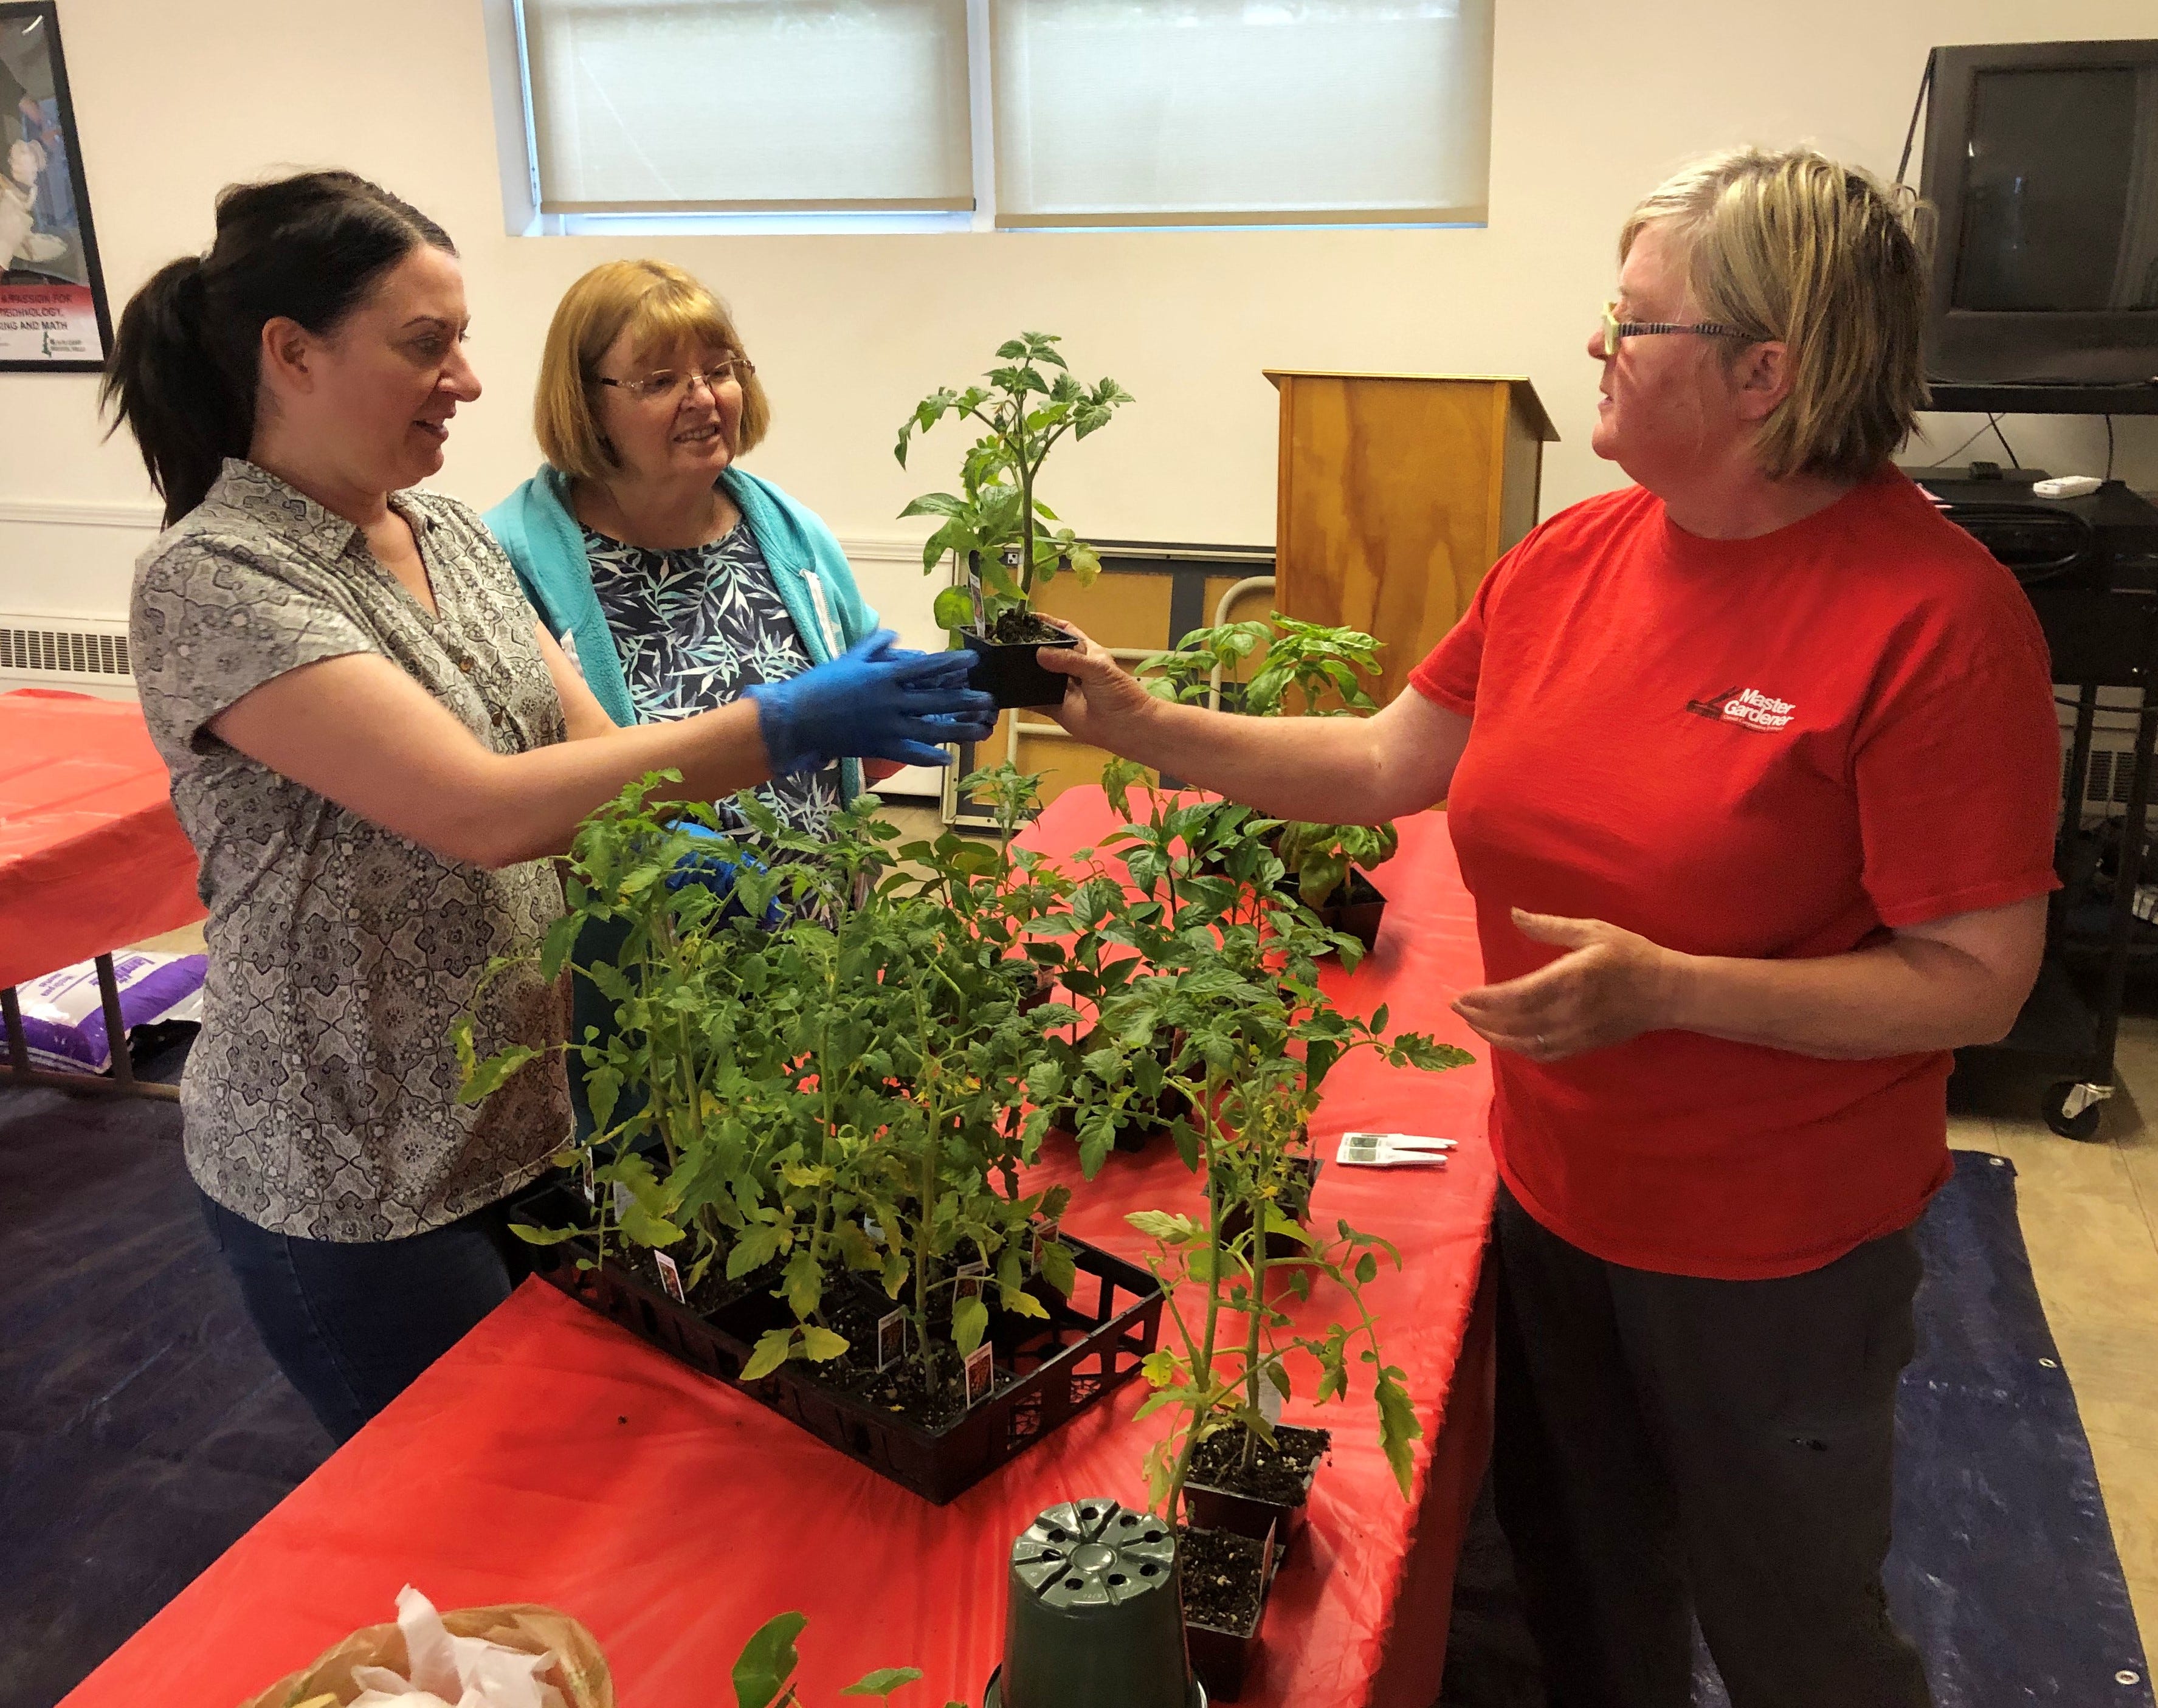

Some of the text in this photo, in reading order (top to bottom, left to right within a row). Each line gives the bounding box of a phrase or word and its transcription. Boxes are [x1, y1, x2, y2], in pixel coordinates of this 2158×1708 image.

[8, 294, 49, 303] PASSION
[52, 294, 72, 303] FOR
[20, 322, 40, 330] AND
[41, 322, 68, 330] MATH
[1739, 688, 1796, 714] Master
[1724, 700, 1794, 726] Gardener
